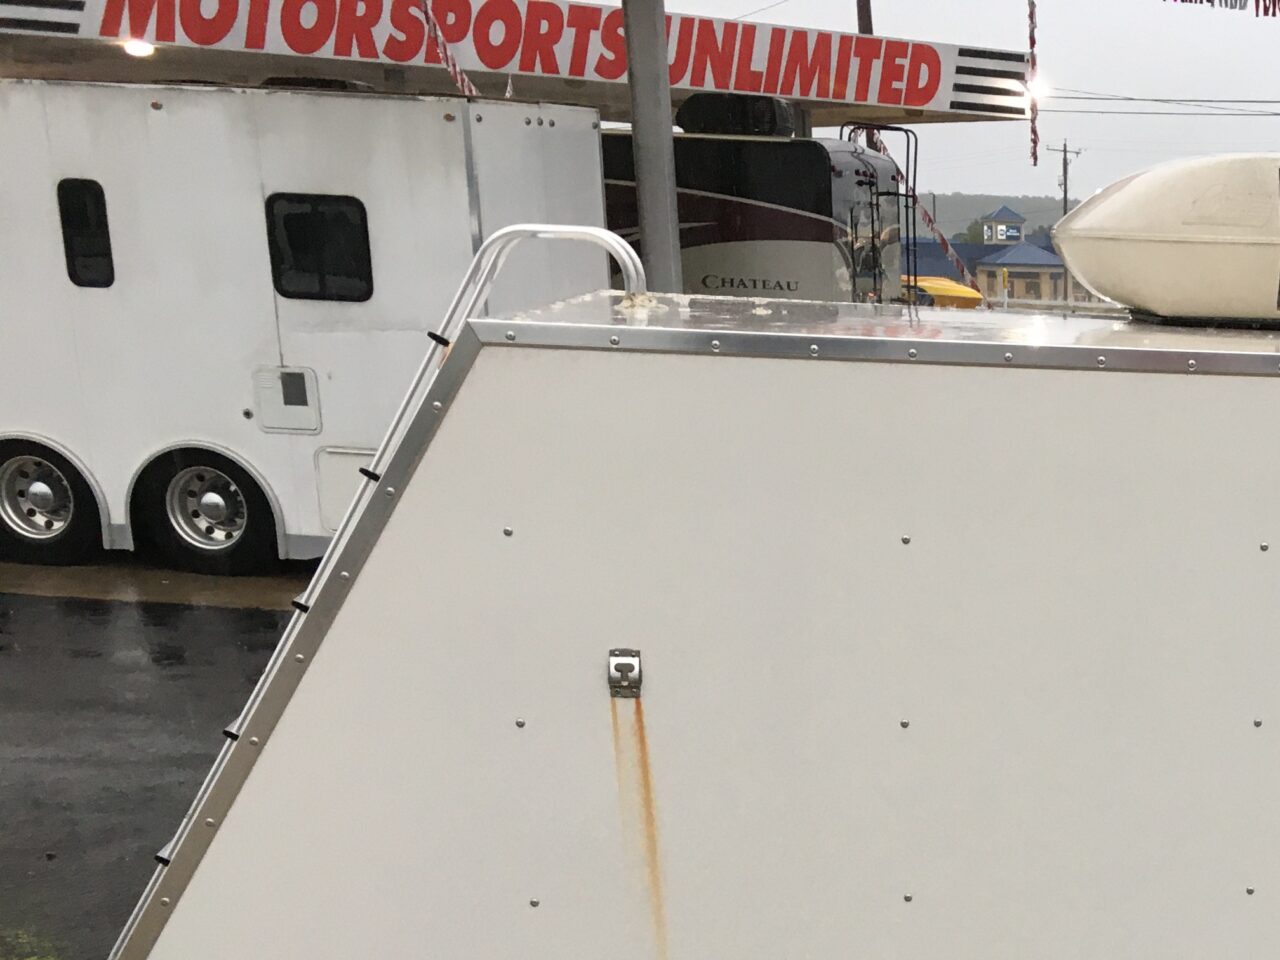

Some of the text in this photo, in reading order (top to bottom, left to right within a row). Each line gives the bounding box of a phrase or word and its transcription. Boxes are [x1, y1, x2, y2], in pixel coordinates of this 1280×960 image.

[99, 0, 941, 107] MOTORSPORTS UNLIMITED
[701, 274, 800, 291] CHATEAU
